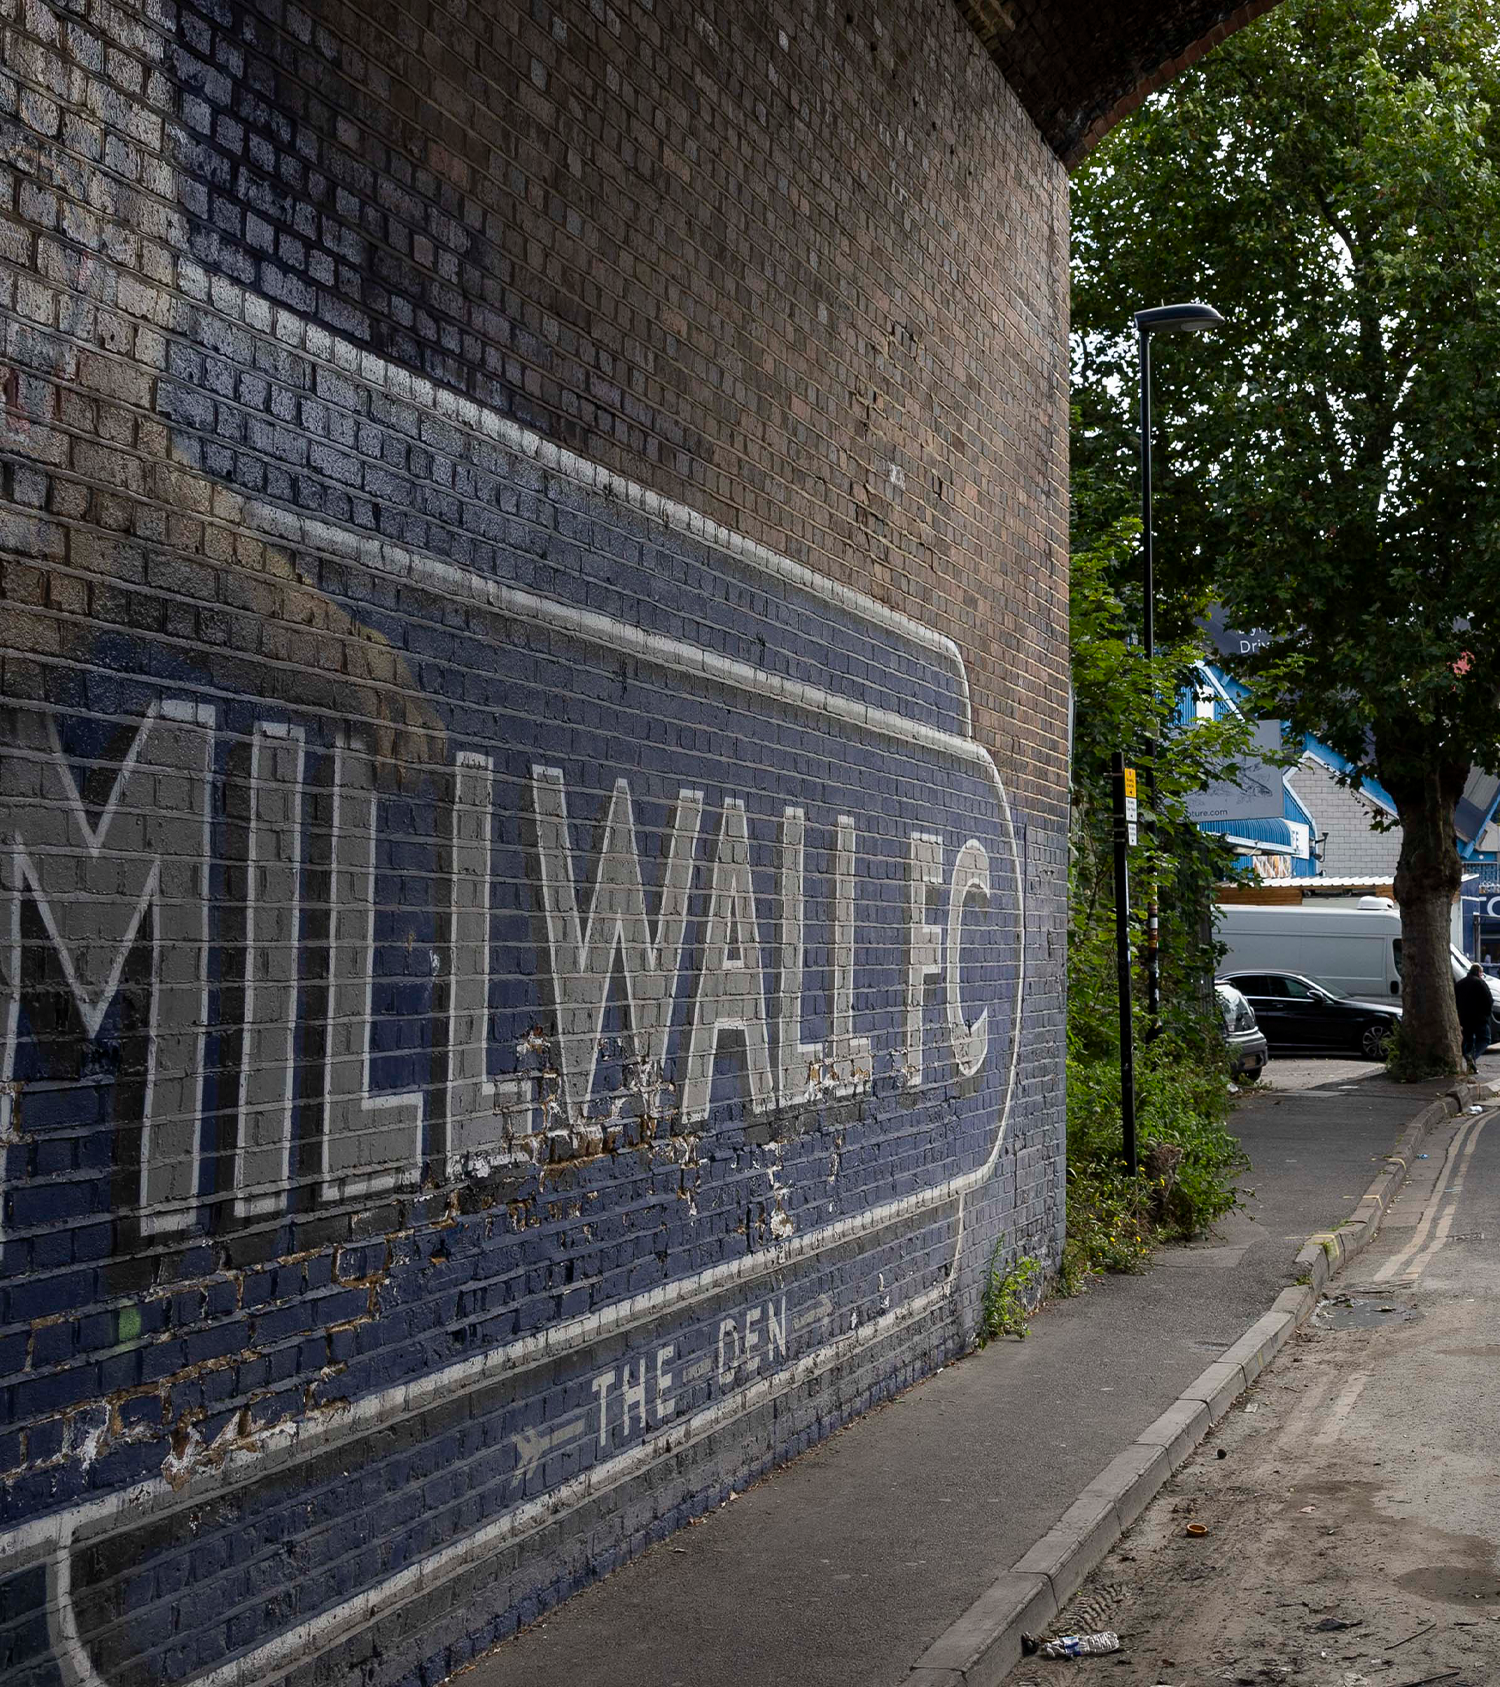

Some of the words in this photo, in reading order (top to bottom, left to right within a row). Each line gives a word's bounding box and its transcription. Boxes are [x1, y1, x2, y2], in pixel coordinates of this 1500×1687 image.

[0, 698, 871, 1242] MILLWALL
[906, 829, 990, 1087] FC
[592, 1343, 675, 1447] THE
[718, 1296, 788, 1385] DEN
